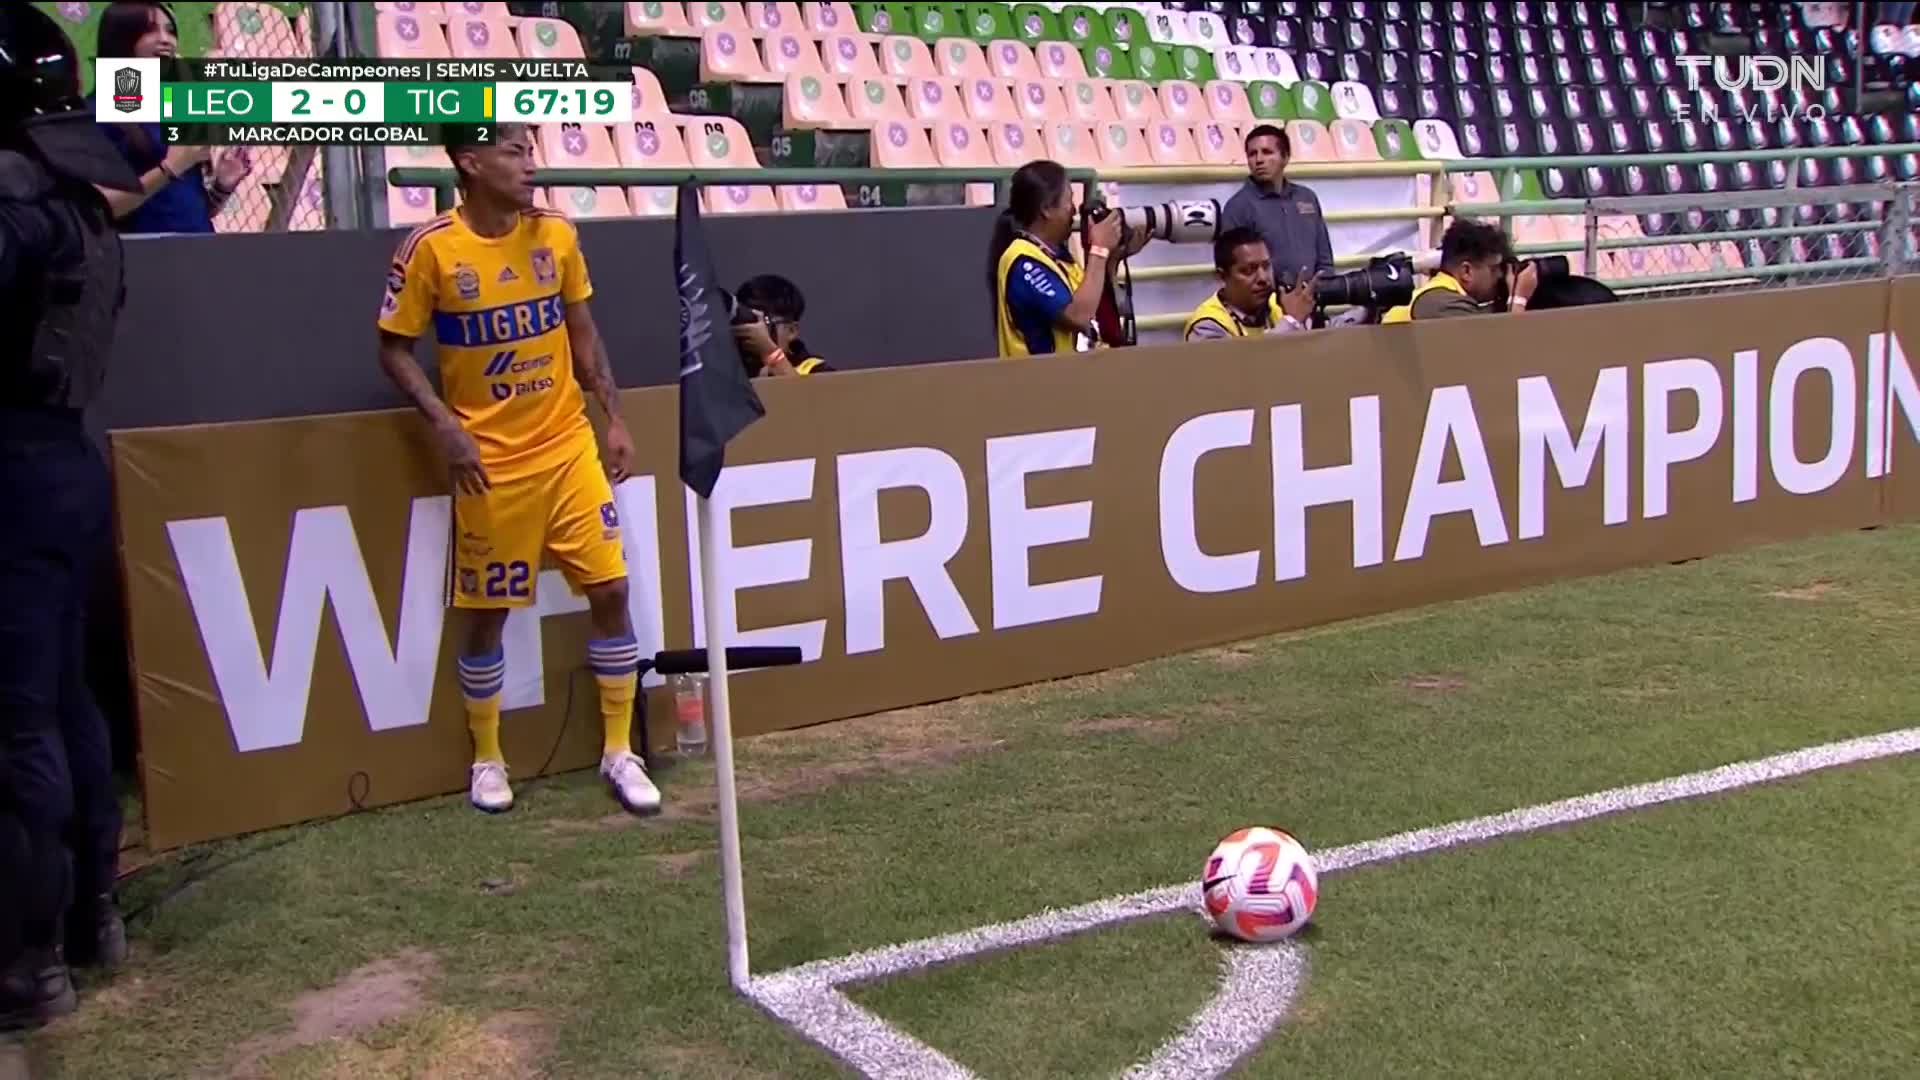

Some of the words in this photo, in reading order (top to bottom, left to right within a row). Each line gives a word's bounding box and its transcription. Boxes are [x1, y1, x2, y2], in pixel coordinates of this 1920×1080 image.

[457, 295, 562, 345] TIGRES
[166, 427, 1104, 752] WHERE
[485, 559, 531, 597] 22
